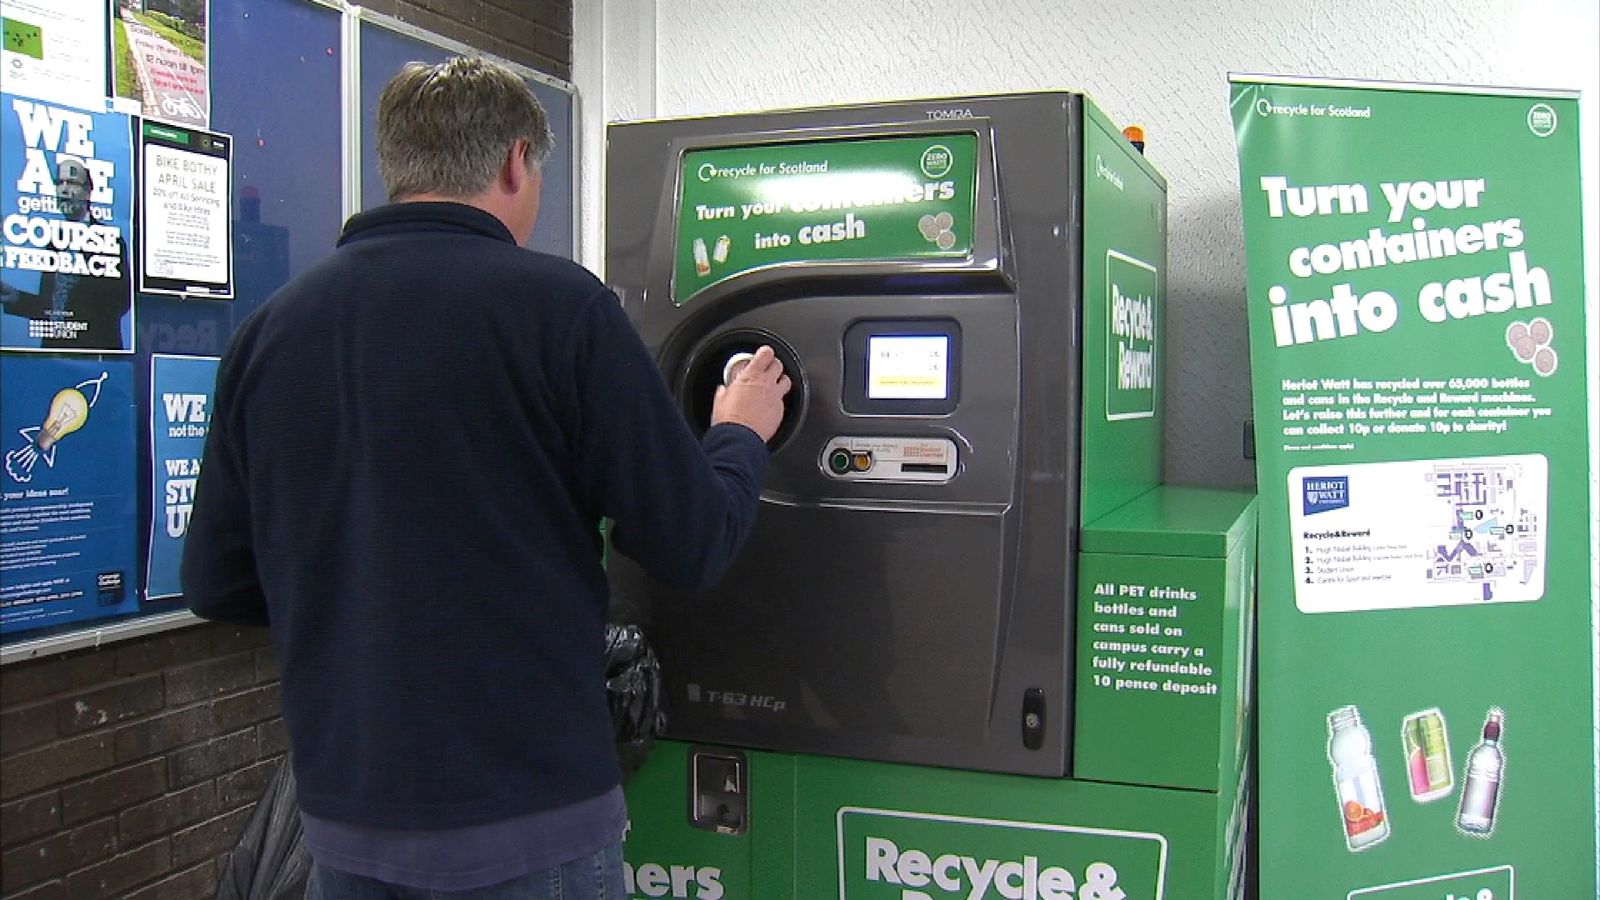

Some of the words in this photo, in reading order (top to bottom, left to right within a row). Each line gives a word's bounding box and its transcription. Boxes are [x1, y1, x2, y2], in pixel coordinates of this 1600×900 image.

[926, 109, 973, 120] TOMRA
[1273, 104, 1308, 116] recycle
[1310, 105, 1326, 116] for
[1328, 106, 1370, 118] Scotland
[13, 99, 94, 158] WE
[156, 155, 180, 171] BIKE
[183, 159, 218, 176] BOTHY
[718, 163, 756, 179] recycle
[760, 163, 775, 174] for
[779, 160, 828, 174] Scotland
[159, 173, 188, 188] APRIL
[191, 177, 217, 194] SALE
[696, 204, 735, 220] Turn
[741, 200, 784, 220] your
[790, 181, 955, 212] coers
[1260, 176, 1368, 217] Turn
[1380, 178, 1485, 223] your
[3, 214, 121, 255] COURSE
[755, 233, 791, 249] into
[797, 213, 865, 245] cash
[1289, 217, 1524, 278] containers
[4, 246, 121, 278] FEEDBACK
[1268, 285, 1398, 348] into
[1418, 250, 1552, 323] cash
[1119, 341, 1152, 389] Reward
[1282, 379, 1318, 390] Heriot
[1320, 379, 1350, 390] Watt
[1353, 378, 1373, 389] has
[1375, 378, 1420, 392] recycled
[1422, 381, 1446, 389] over
[1448, 378, 1488, 390] 65,000
[1491, 377, 1530, 389] bottles
[163, 393, 207, 423] WE
[1282, 393, 1305, 405] and
[1308, 396, 1334, 405] cans
[1337, 393, 1349, 404] in
[1352, 393, 1370, 404] the
[1373, 393, 1413, 407] Recycle
[1416, 393, 1437, 403] and
[1439, 393, 1479, 403] Reward
[1480, 392, 1537, 403] machines.
[1282, 410, 1310, 420] Let's
[1313, 408, 1343, 419] raise
[1346, 408, 1367, 419] this
[1369, 407, 1407, 419] further
[1409, 407, 1431, 417] and
[1433, 407, 1449, 417] for
[1450, 407, 1476, 417] each
[1477, 405, 1530, 417] container
[1532, 408, 1552, 419] you
[169, 424, 186, 438] not
[1283, 427, 1304, 436] can
[1306, 423, 1344, 434] collect
[1349, 423, 1370, 437] 10p
[1372, 425, 1385, 433] or
[1387, 422, 1427, 433] donate
[1430, 421, 1451, 434] 10p
[1452, 421, 1464, 432] to
[1465, 420, 1507, 433] charity!
[165, 459, 189, 476] WE
[190, 458, 203, 476] A
[1306, 481, 1345, 491] HERIOT
[1318, 491, 1345, 499] WATT
[1303, 529, 1370, 539] Recycle&Reward
[1304, 546, 1314, 554] 1.
[1304, 556, 1315, 564] 2.
[1094, 583, 1114, 596] All
[1119, 584, 1145, 598] PET
[1149, 586, 1197, 600] drinks
[1093, 601, 1145, 616] bottles
[1148, 606, 1178, 618] and
[1093, 622, 1125, 633] cans
[1129, 623, 1160, 635] sold
[1163, 627, 1183, 636] on
[1093, 641, 1148, 653] campus
[1150, 644, 1190, 658] carry
[1193, 647, 1204, 657] a
[1092, 656, 1126, 672] fully
[1129, 660, 1213, 676] refundable
[1093, 675, 1111, 686] 10
[1115, 679, 1158, 691] pence
[1162, 680, 1218, 695] deposit
[706, 691, 747, 705] T-63
[866, 836, 1126, 900] Recycle&
